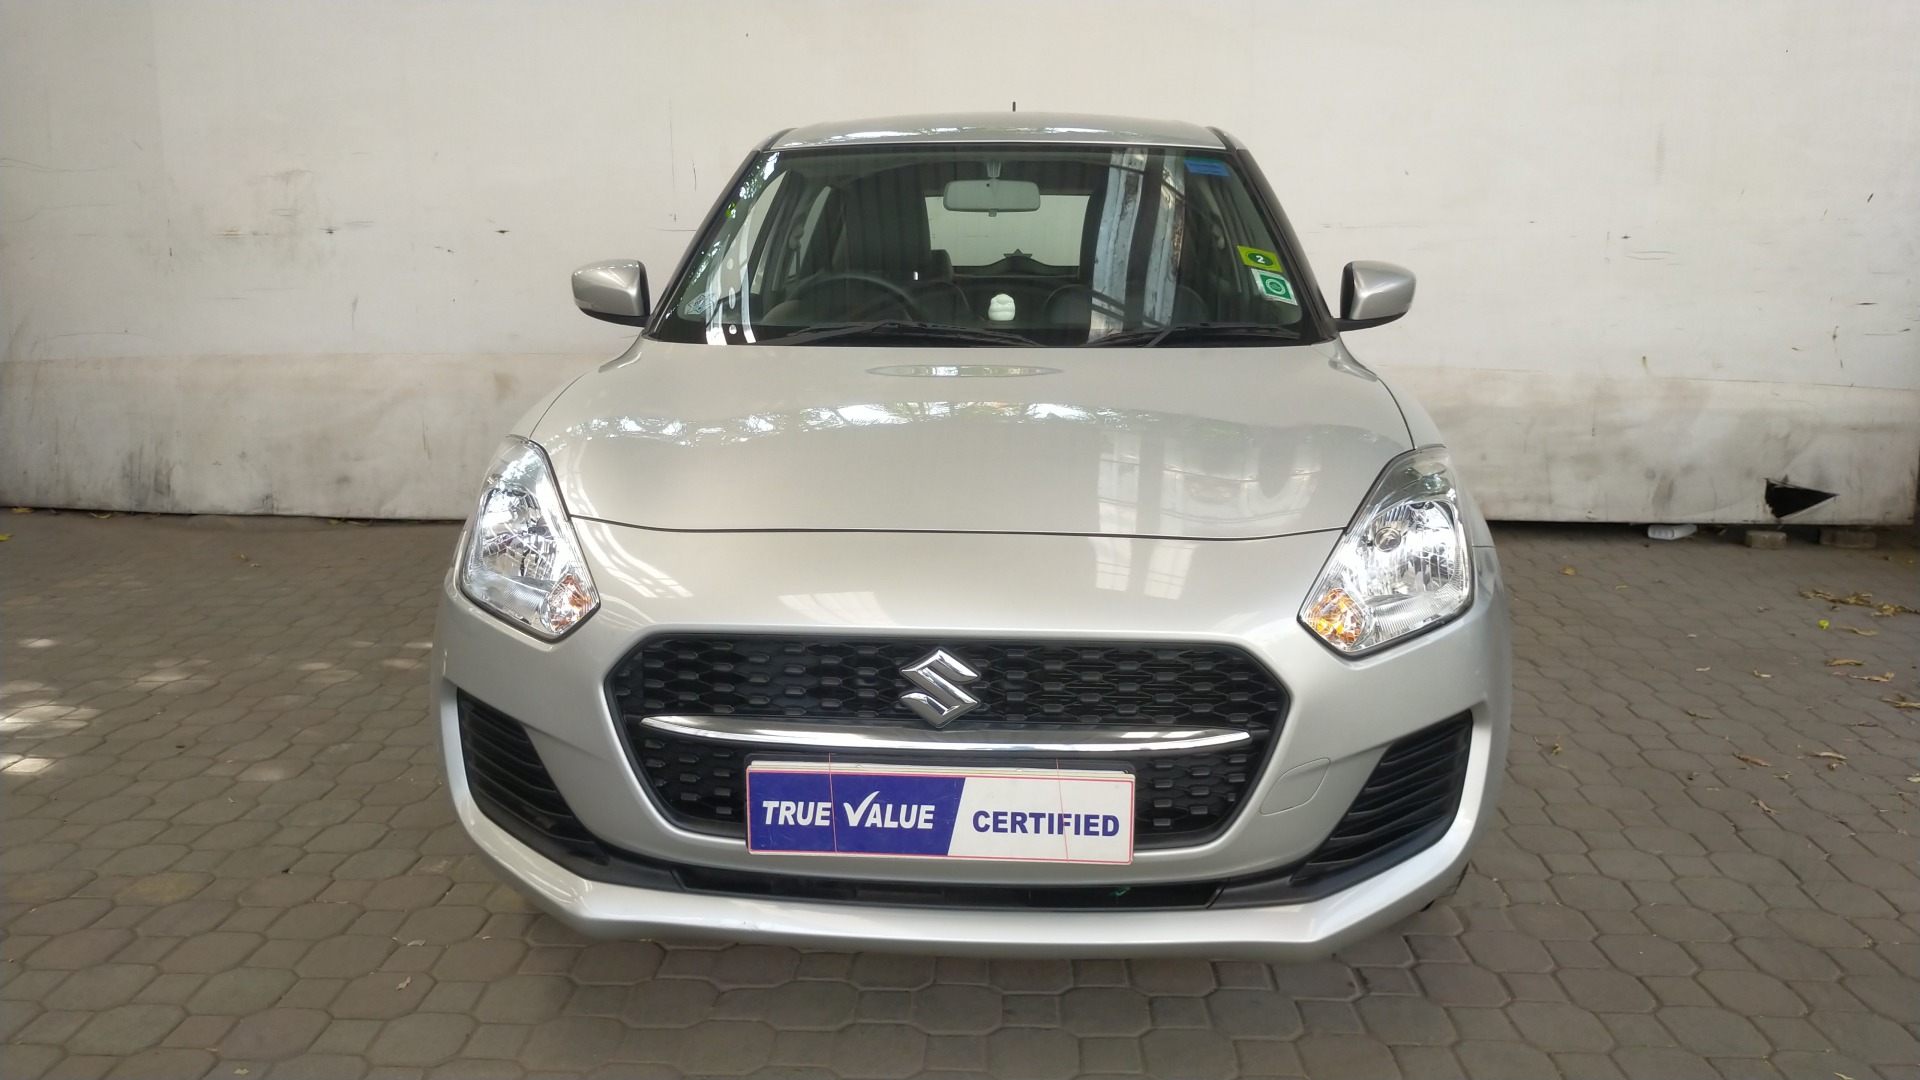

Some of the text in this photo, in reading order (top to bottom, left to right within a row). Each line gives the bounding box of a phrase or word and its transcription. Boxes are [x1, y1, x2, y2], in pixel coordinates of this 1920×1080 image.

[1255, 254, 1266, 264] 2
[762, 791, 1120, 837] TRUE VALUE CERTIFIED
